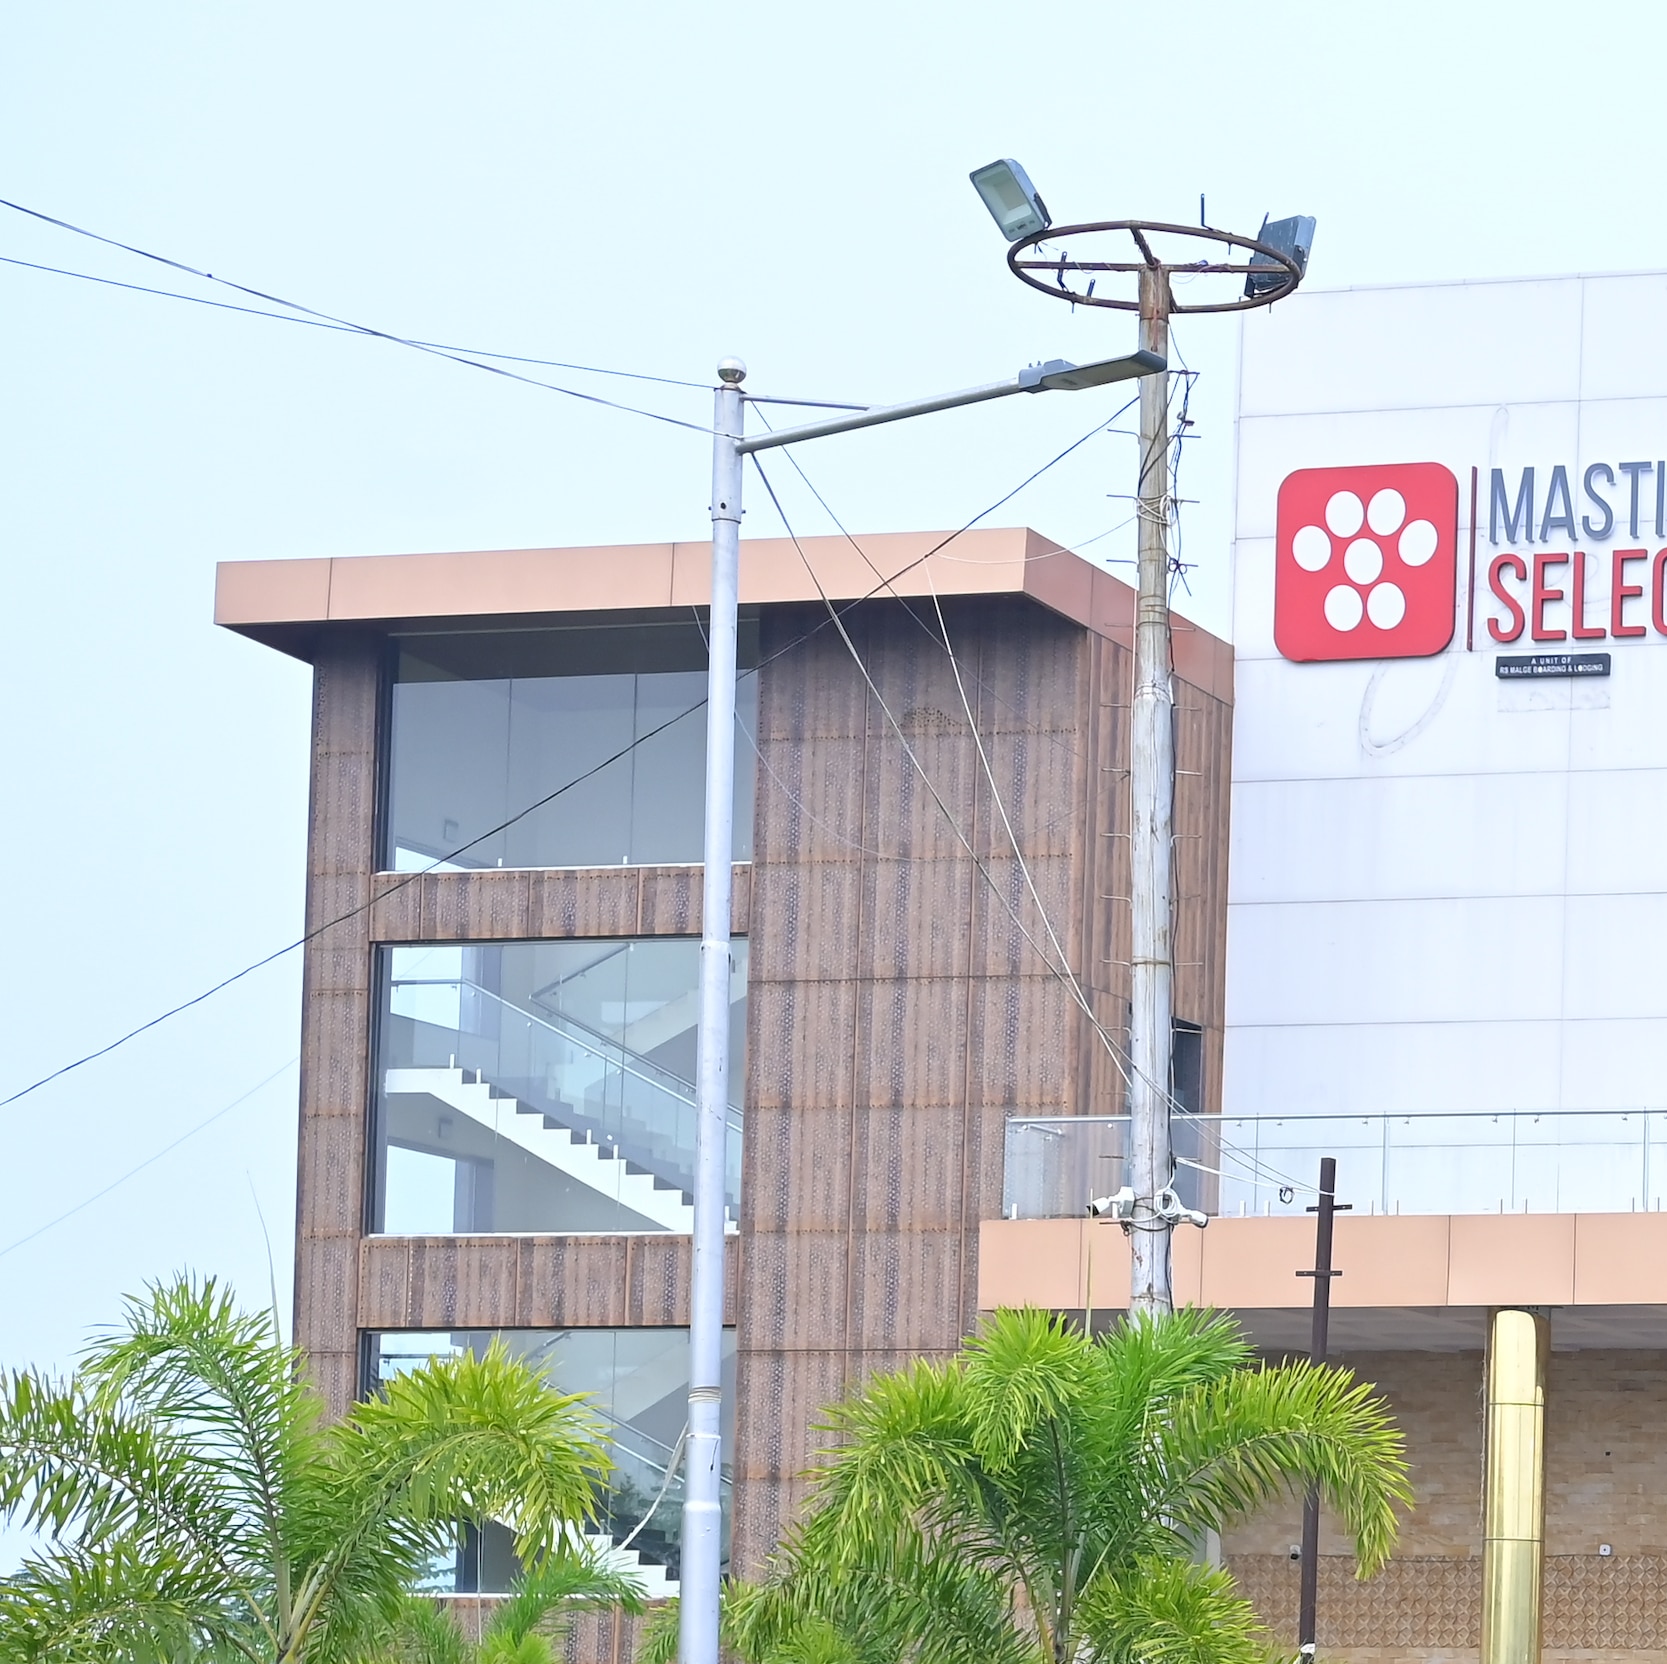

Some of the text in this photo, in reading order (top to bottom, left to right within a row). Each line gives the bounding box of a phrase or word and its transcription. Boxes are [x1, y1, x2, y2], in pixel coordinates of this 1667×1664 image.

[1540, 657, 1558, 665] UNIT
[1533, 664, 1566, 673] BOARDING
[1574, 663, 1603, 672] LODGING
